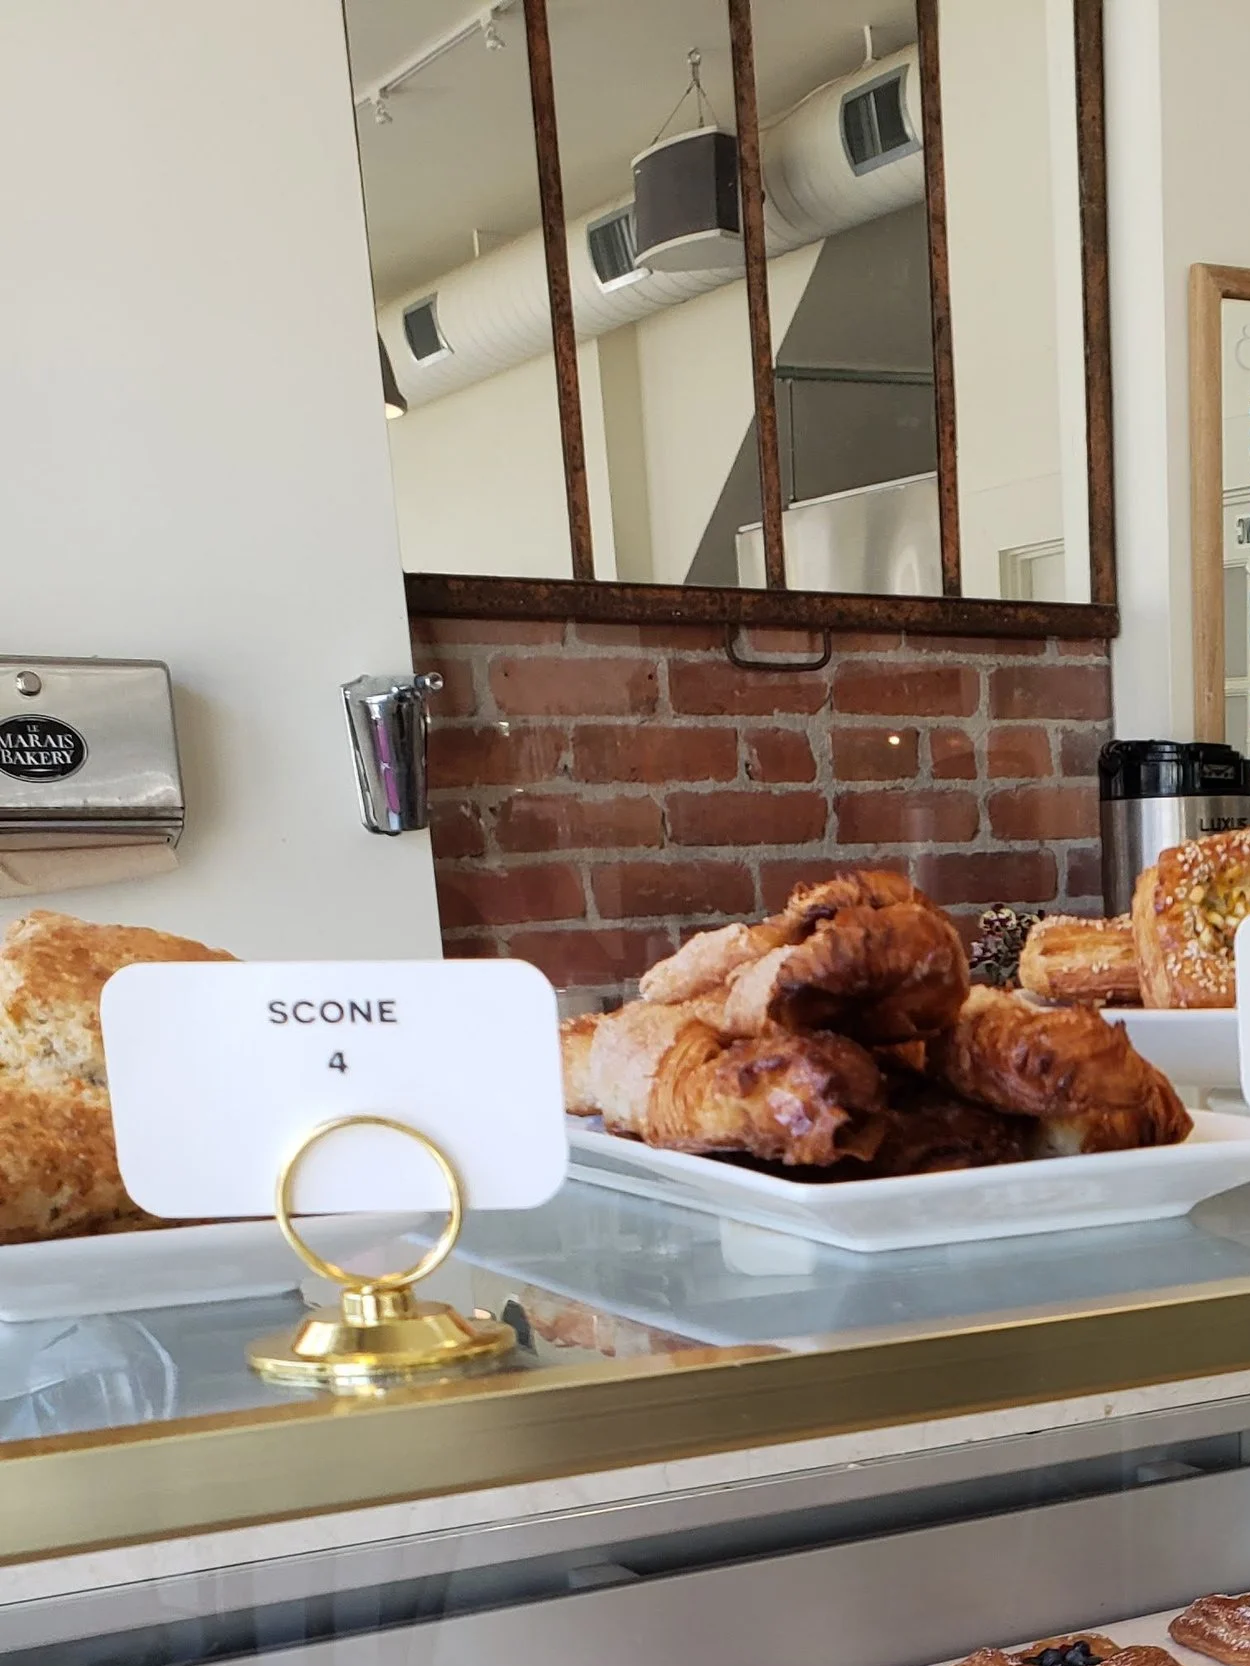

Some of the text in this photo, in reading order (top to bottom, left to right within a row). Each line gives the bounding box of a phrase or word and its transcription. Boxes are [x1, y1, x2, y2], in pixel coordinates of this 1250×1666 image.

[26, 724, 40, 733] LE
[0, 749, 75, 766] BAKERY
[268, 999, 398, 1026] SCONE
[328, 1051, 349, 1074] 4
